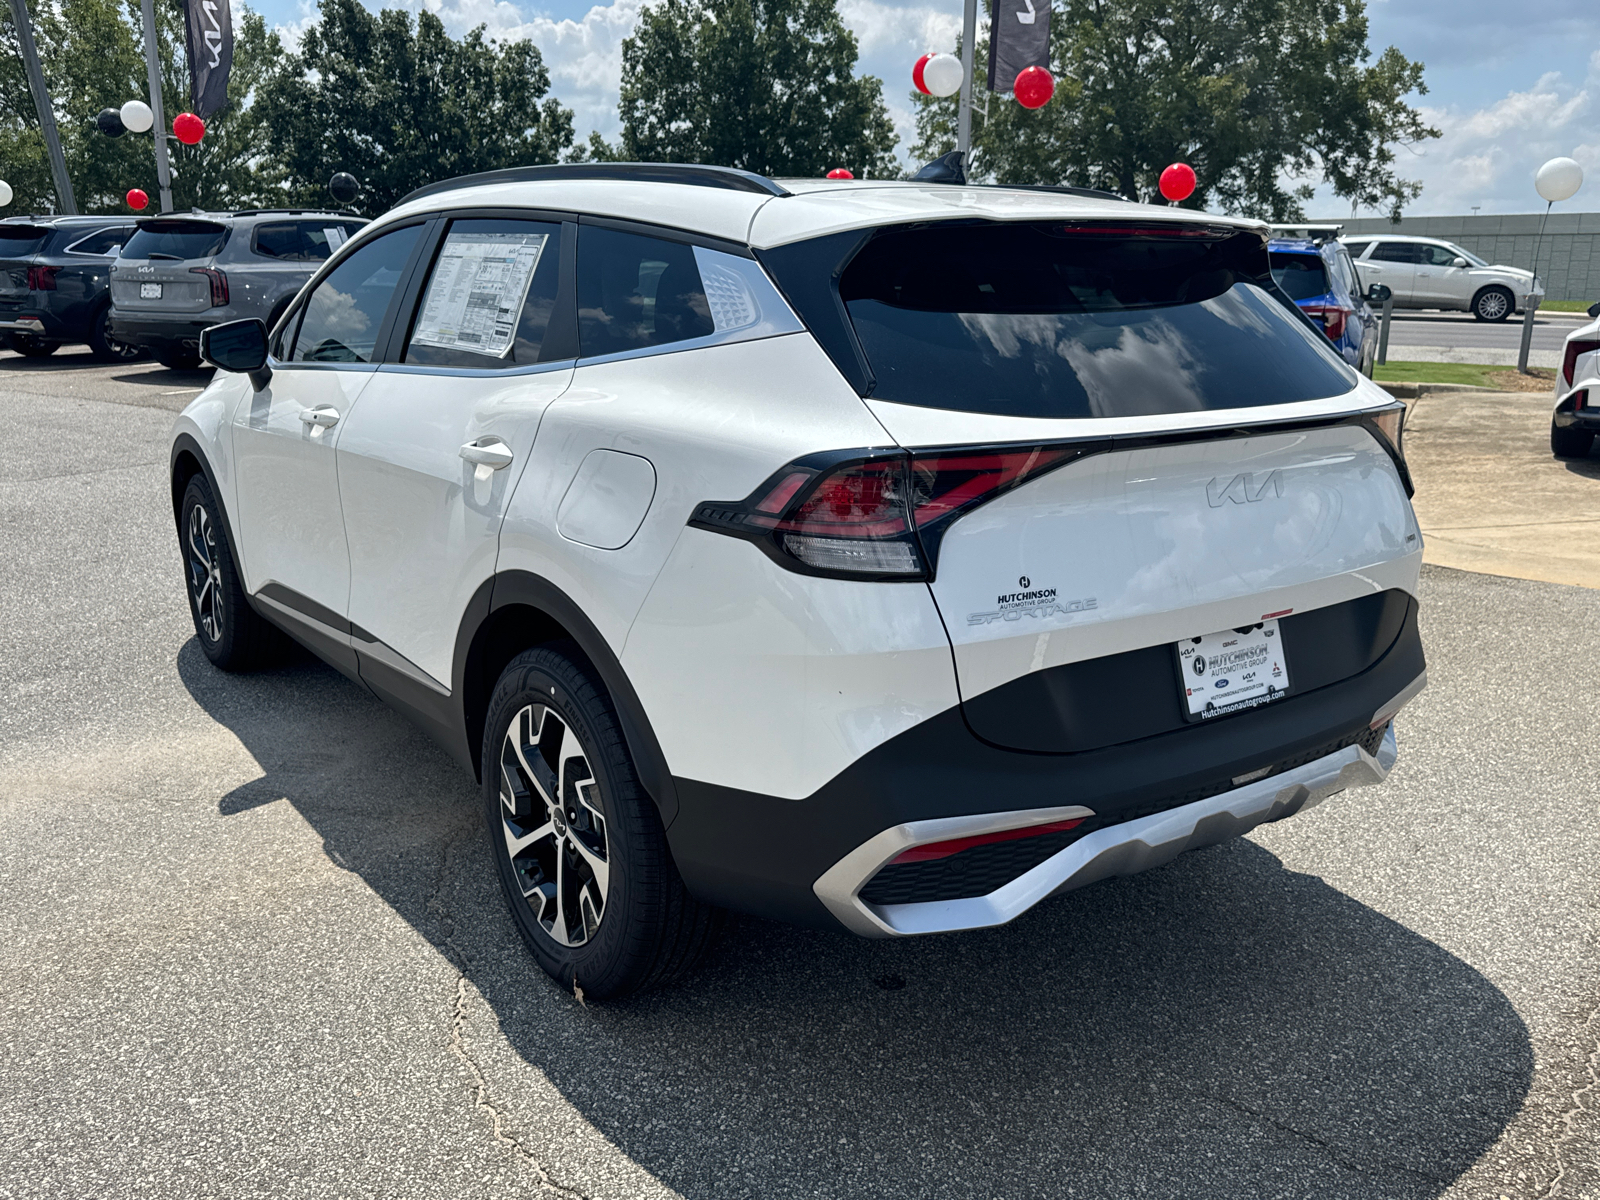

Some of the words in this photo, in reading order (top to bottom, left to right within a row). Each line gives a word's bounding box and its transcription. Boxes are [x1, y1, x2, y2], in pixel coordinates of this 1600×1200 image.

[1205, 469, 1285, 508] KIA
[997, 588, 1057, 604] HUTCHINSON
[1000, 600, 1036, 610] AUTOMOTIVE
[966, 598, 1099, 626] SPORTAGE
[1208, 643, 1269, 670] HUTCHINSON
[1222, 640, 1238, 648] GMC
[1211, 661, 1248, 677] AUTOMOTIVE
[1248, 656, 1268, 667] GROUP
[1201, 690, 1285, 719] Hutchinsonautogroup.com
[563, 698, 593, 745] FINESSE
[583, 885, 622, 979] GOODYEAR
